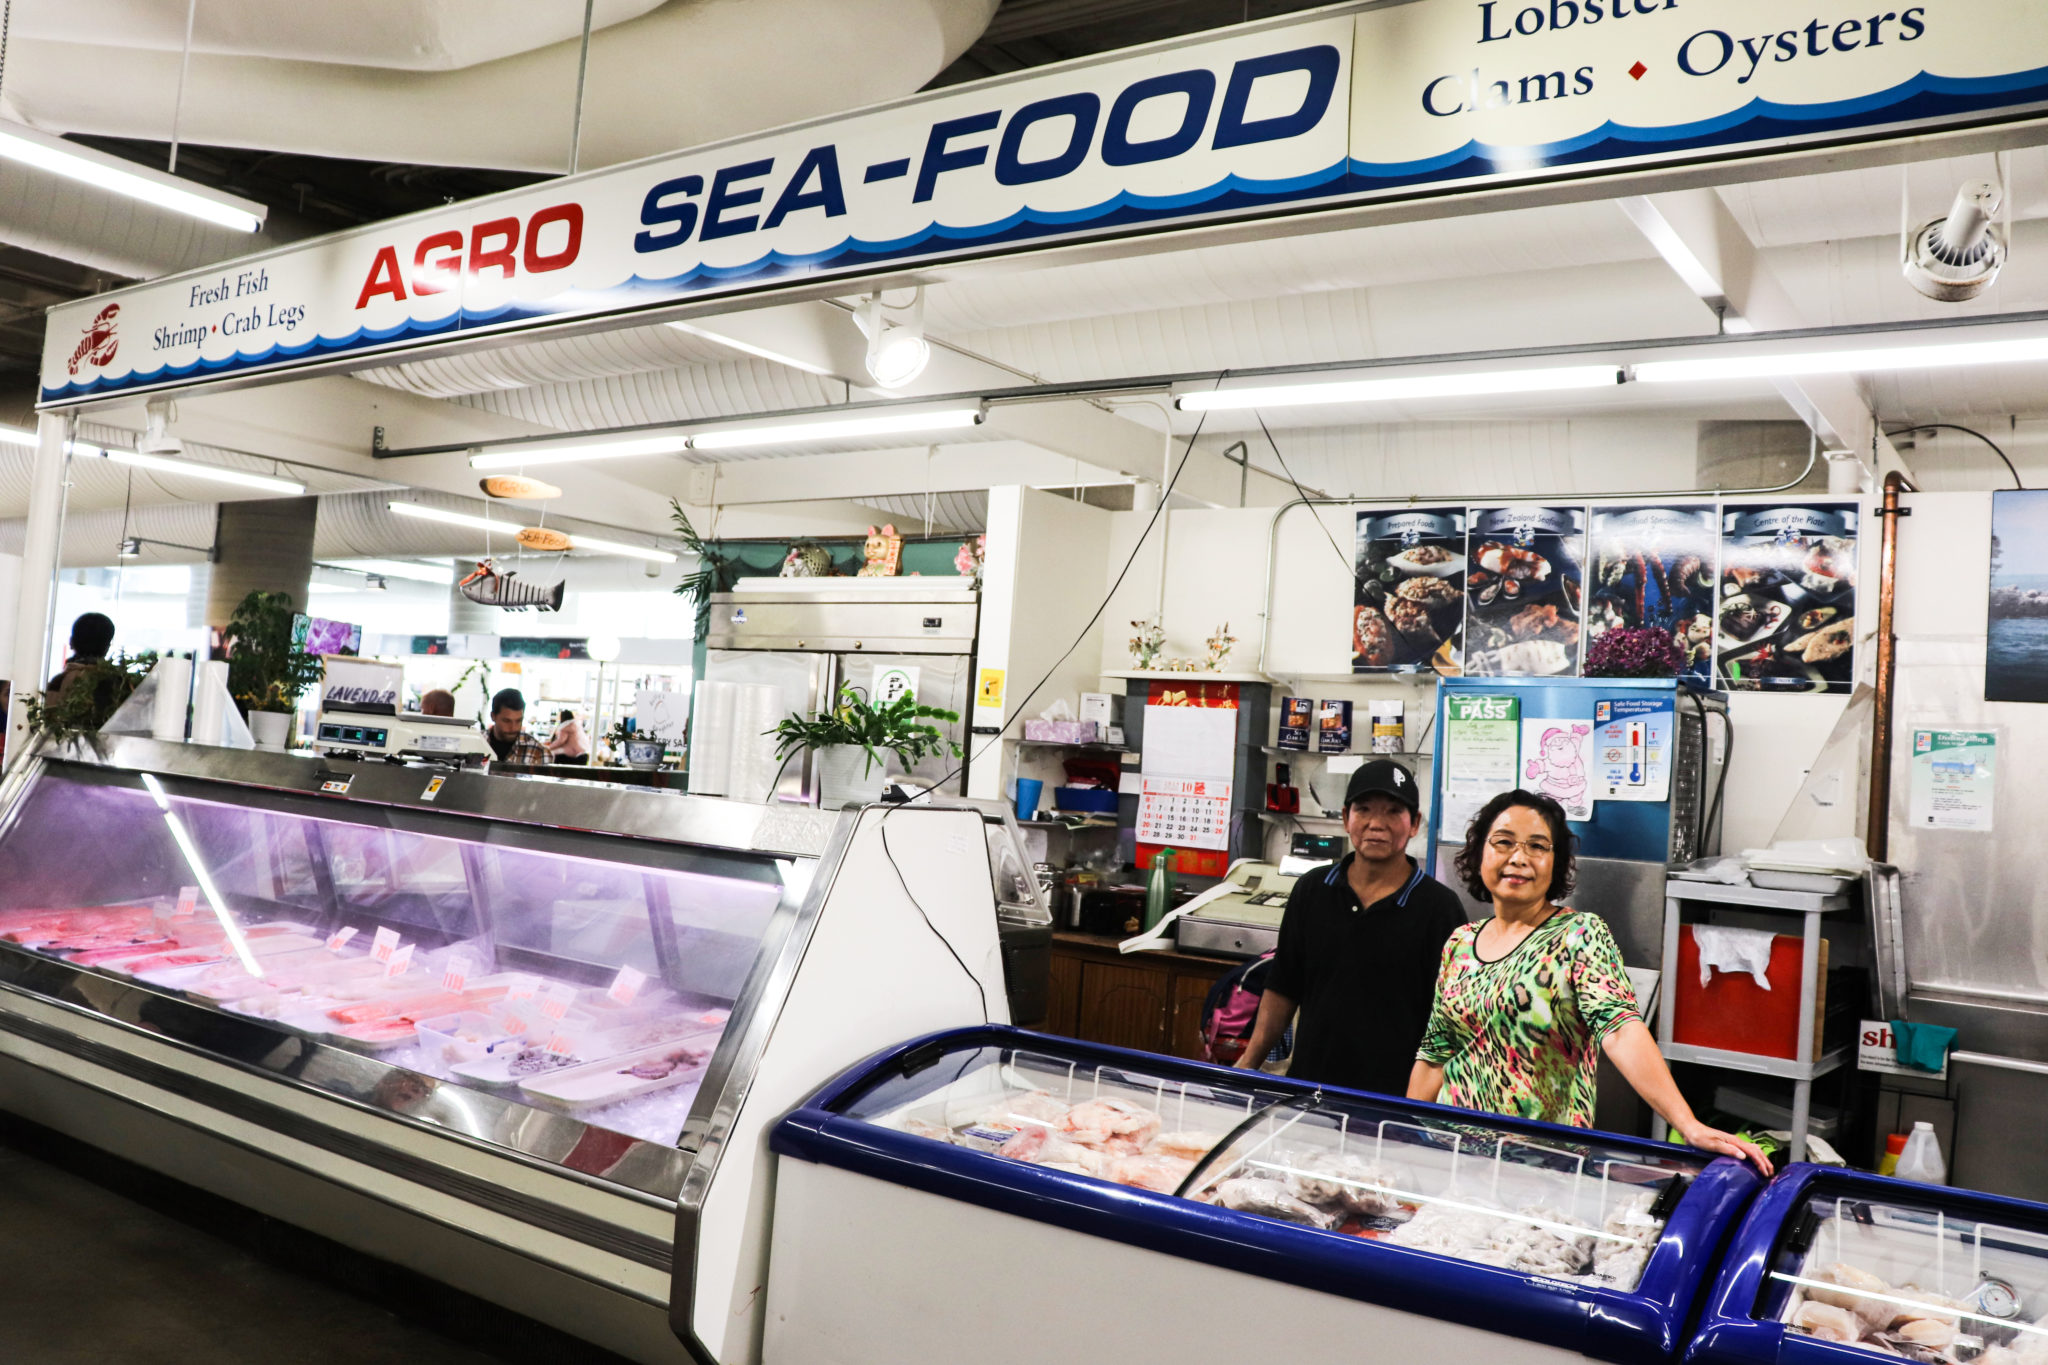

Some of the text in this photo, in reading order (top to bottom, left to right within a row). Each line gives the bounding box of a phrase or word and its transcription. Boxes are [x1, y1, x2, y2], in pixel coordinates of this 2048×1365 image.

[1422, 6, 1926, 117] Clams Oysters
[355, 45, 1340, 309] AGRO SEA-FOOD
[189, 268, 269, 308] Fresh Fish
[153, 304, 305, 350] Shrimp Crab Legs
[1387, 518, 1435, 529] Prepared Foods
[1507, 513, 1536, 523] Zealand
[1753, 514, 1825, 527] Centre of the Plate
[326, 685, 396, 704] LAVENDER
[1641, 700, 1663, 708] Storage
[1461, 705, 1507, 719] PASS
[1182, 782, 1192, 793] 10
